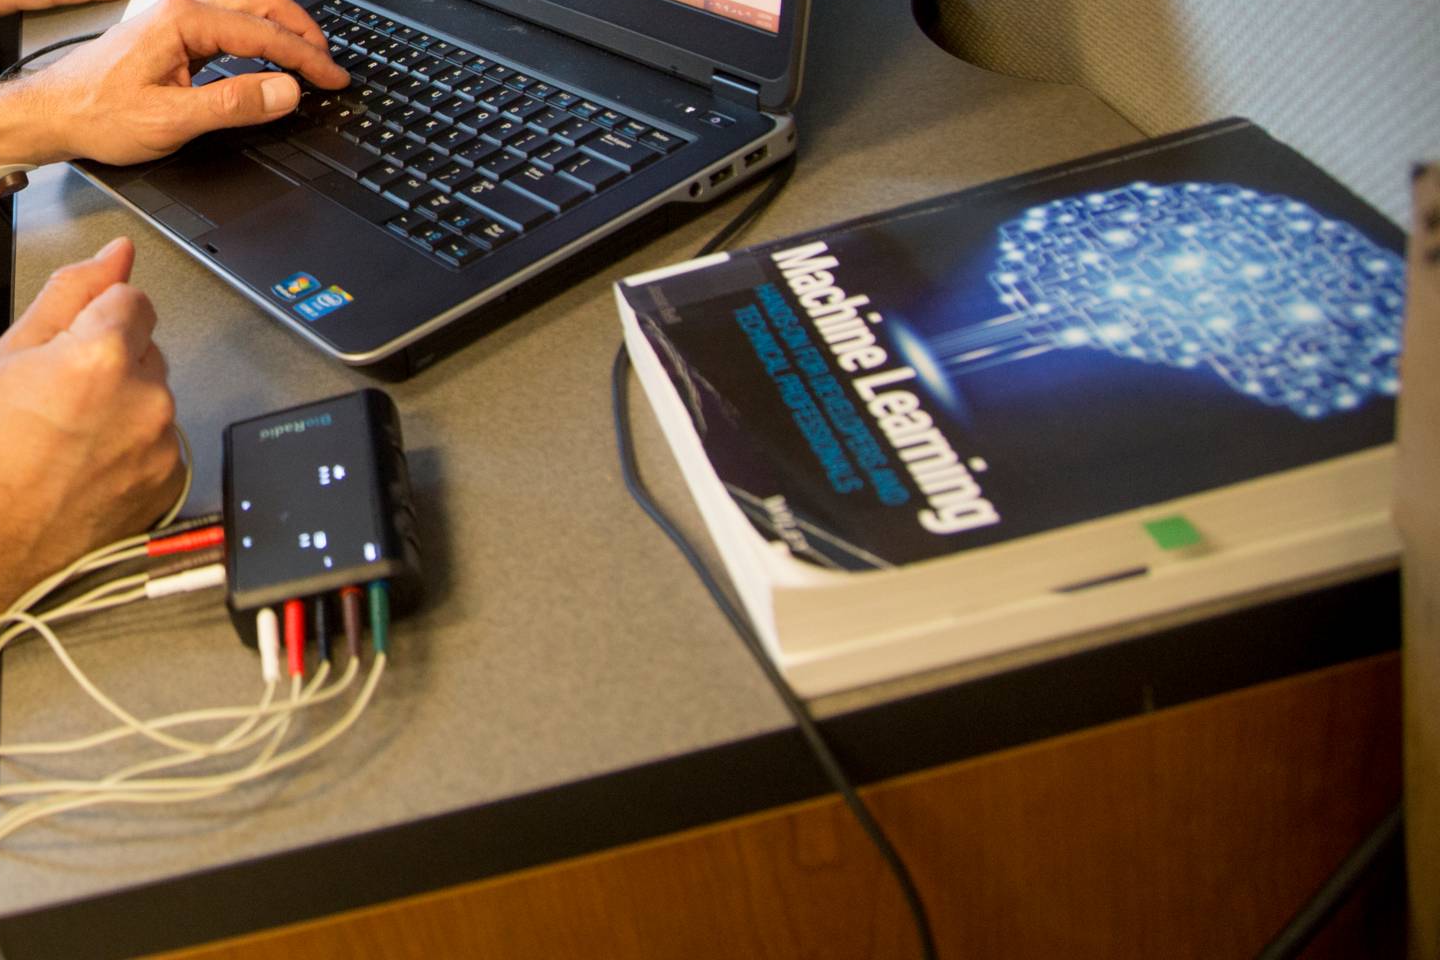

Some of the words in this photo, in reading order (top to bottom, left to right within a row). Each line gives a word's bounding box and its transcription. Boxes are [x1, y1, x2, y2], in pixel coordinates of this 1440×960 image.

[259, 412, 334, 440] BioRadio
[771, 240, 887, 373] Machine
[853, 366, 1001, 534] Learning
